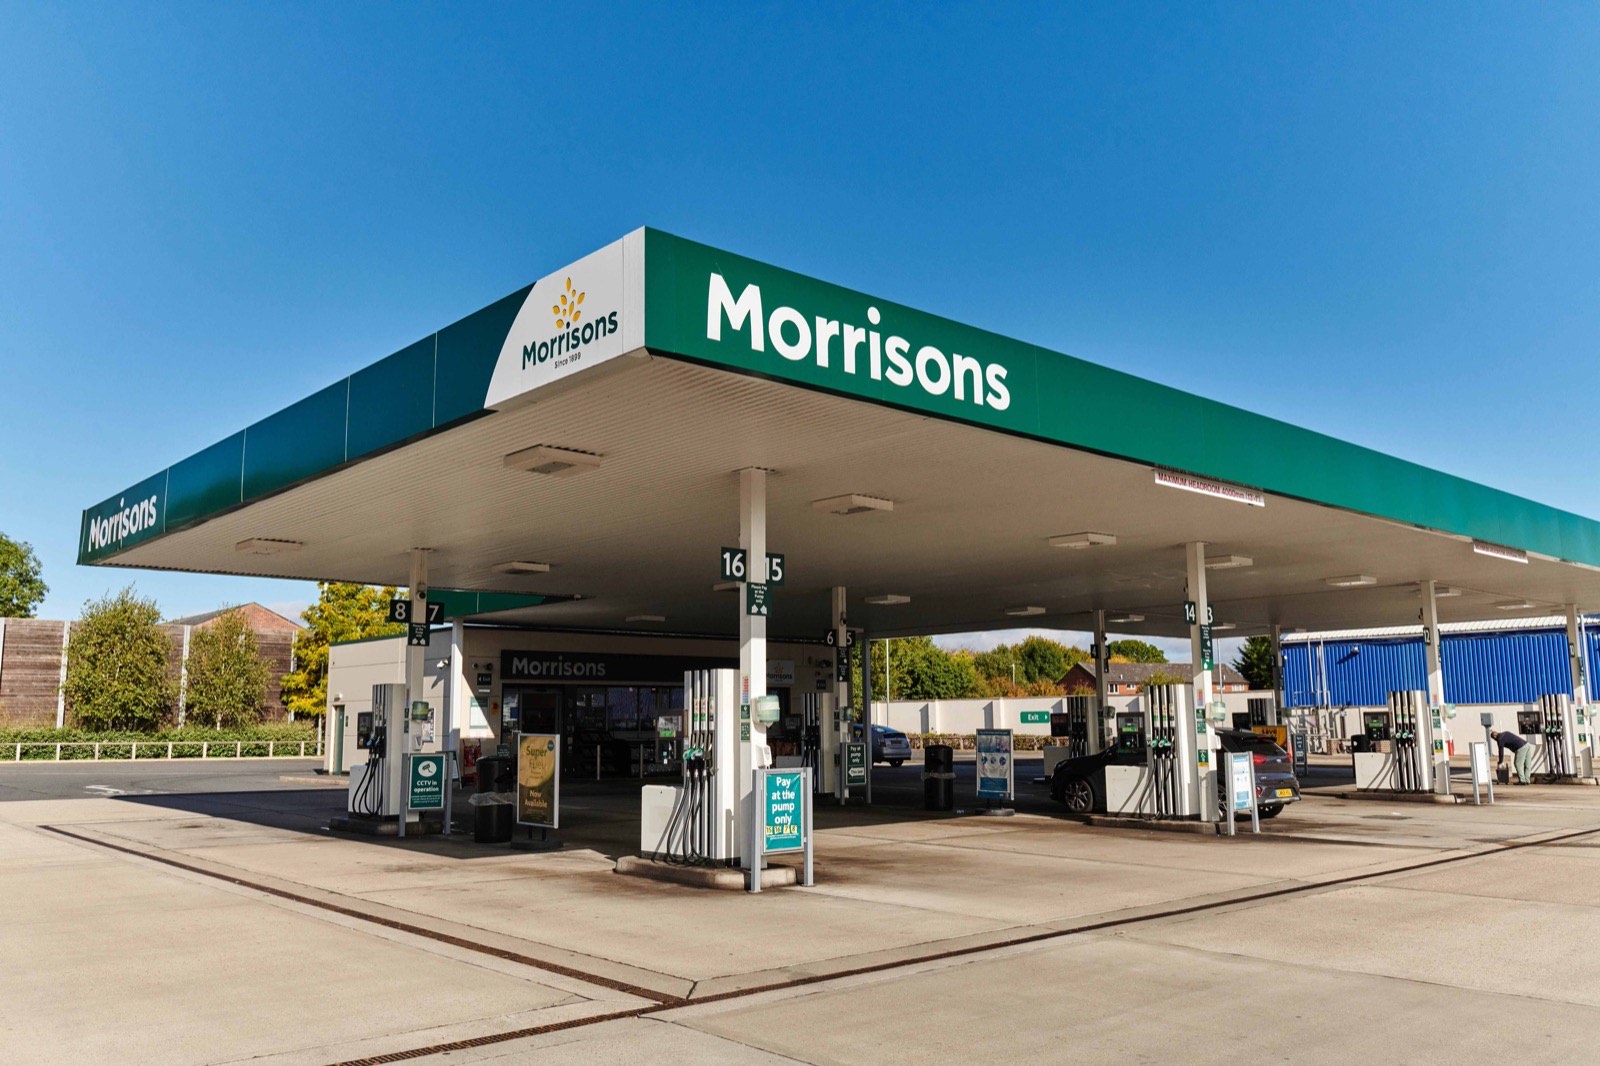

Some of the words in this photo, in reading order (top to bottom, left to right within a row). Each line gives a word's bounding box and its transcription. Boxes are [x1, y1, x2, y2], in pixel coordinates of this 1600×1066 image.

[522, 311, 619, 371] Morrisons
[707, 272, 1011, 411] Morrisons
[554, 357, 569, 369] Since
[569, 351, 582, 364] 1899
[1158, 472, 1187, 485] MAXIMUM
[1188, 480, 1221, 493] HEADROOM
[88, 495, 157, 553] Morrisons
[723, 552, 745, 578] 16
[765, 557, 783, 582] 15
[395, 602, 406, 620] 8
[429, 604, 440, 622] 7
[1184, 603, 1196, 622] 14
[1206, 606, 1213, 624] 3
[826, 631, 834, 645] 6
[846, 632, 853, 645] 5
[1423, 630, 1430, 642] 12
[1091, 646, 1097, 659] 4
[512, 655, 607, 676] Morrisons
[1027, 713, 1039, 721] Exit
[526, 745, 548, 760] Super
[776, 776, 791, 789] Pay
[529, 789, 542, 798] Now
[771, 790, 780, 800] at
[782, 790, 795, 800] the
[524, 799, 548, 808] Available
[772, 803, 795, 814] pump
[774, 813, 792, 825] only
